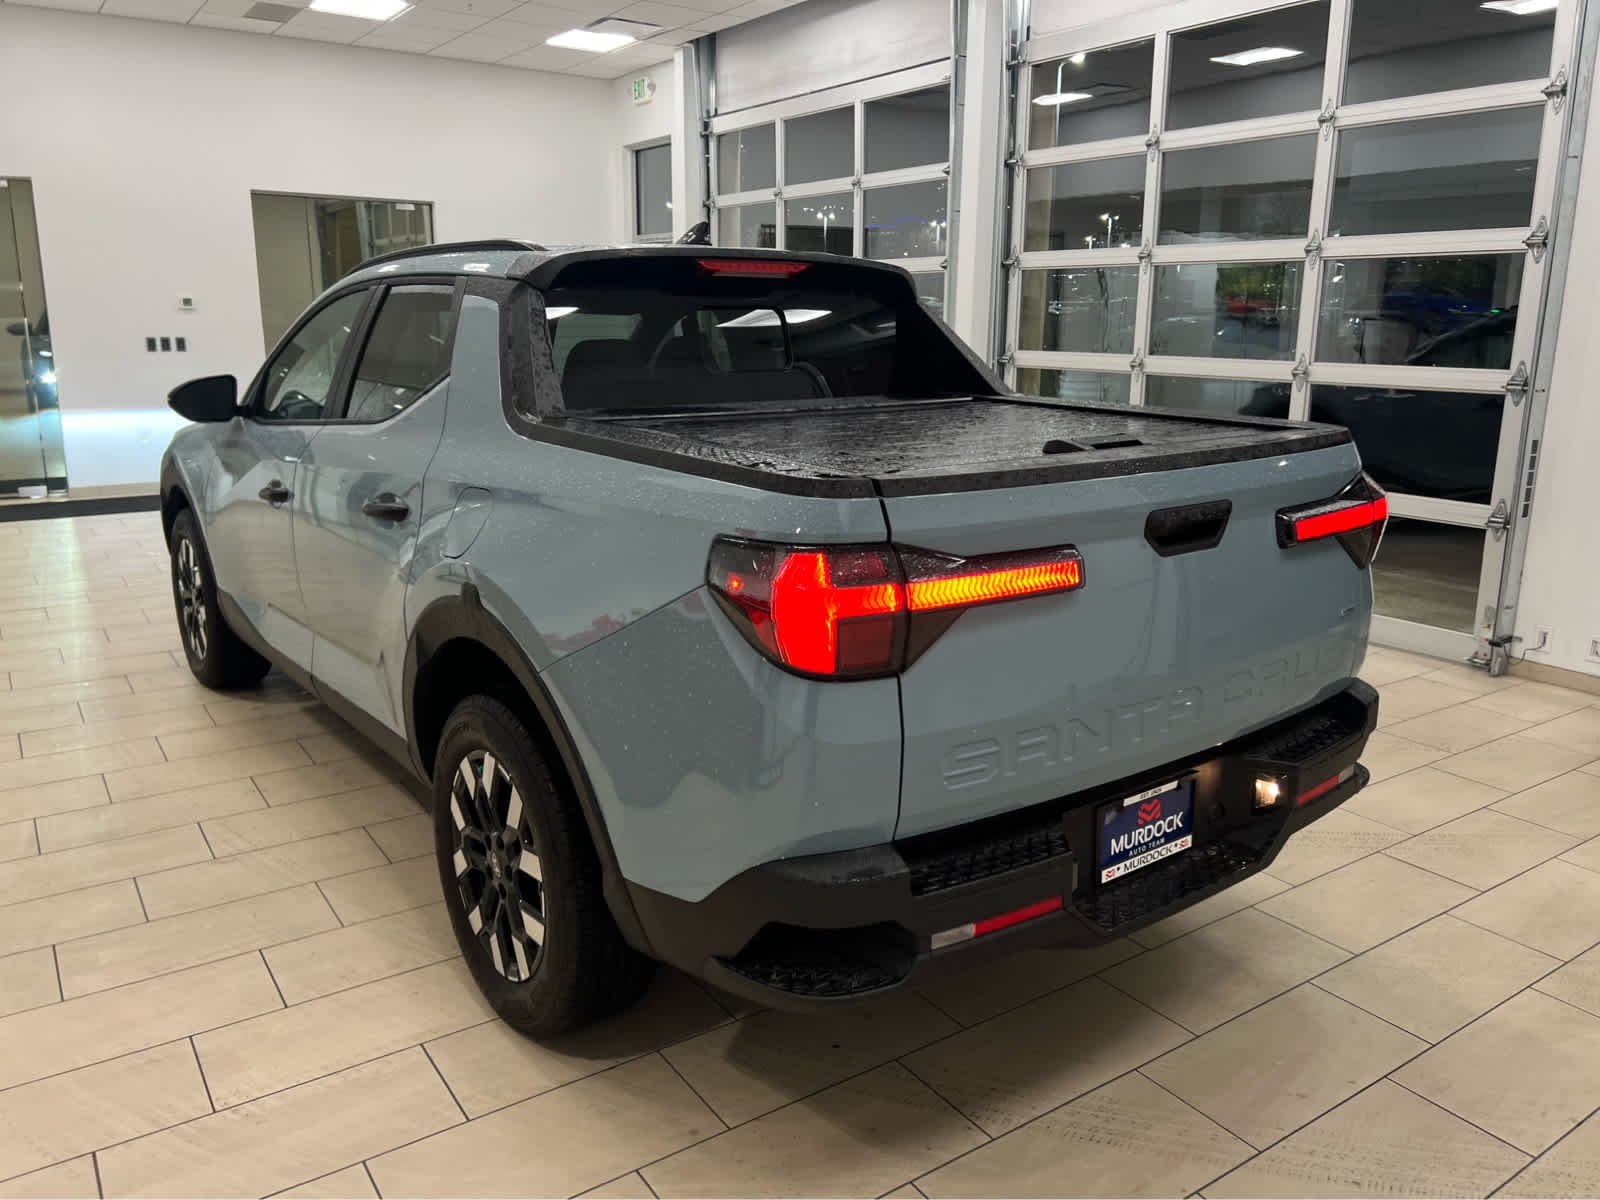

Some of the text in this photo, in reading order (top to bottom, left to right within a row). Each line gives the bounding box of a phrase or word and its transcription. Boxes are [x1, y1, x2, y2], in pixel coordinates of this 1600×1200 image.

[943, 644, 1341, 792] SANTA CRU
[1110, 811, 1183, 856] MURDOCK
[1128, 837, 1165, 857] AUTO TEAM
[1123, 844, 1174, 872] MURDOCK
